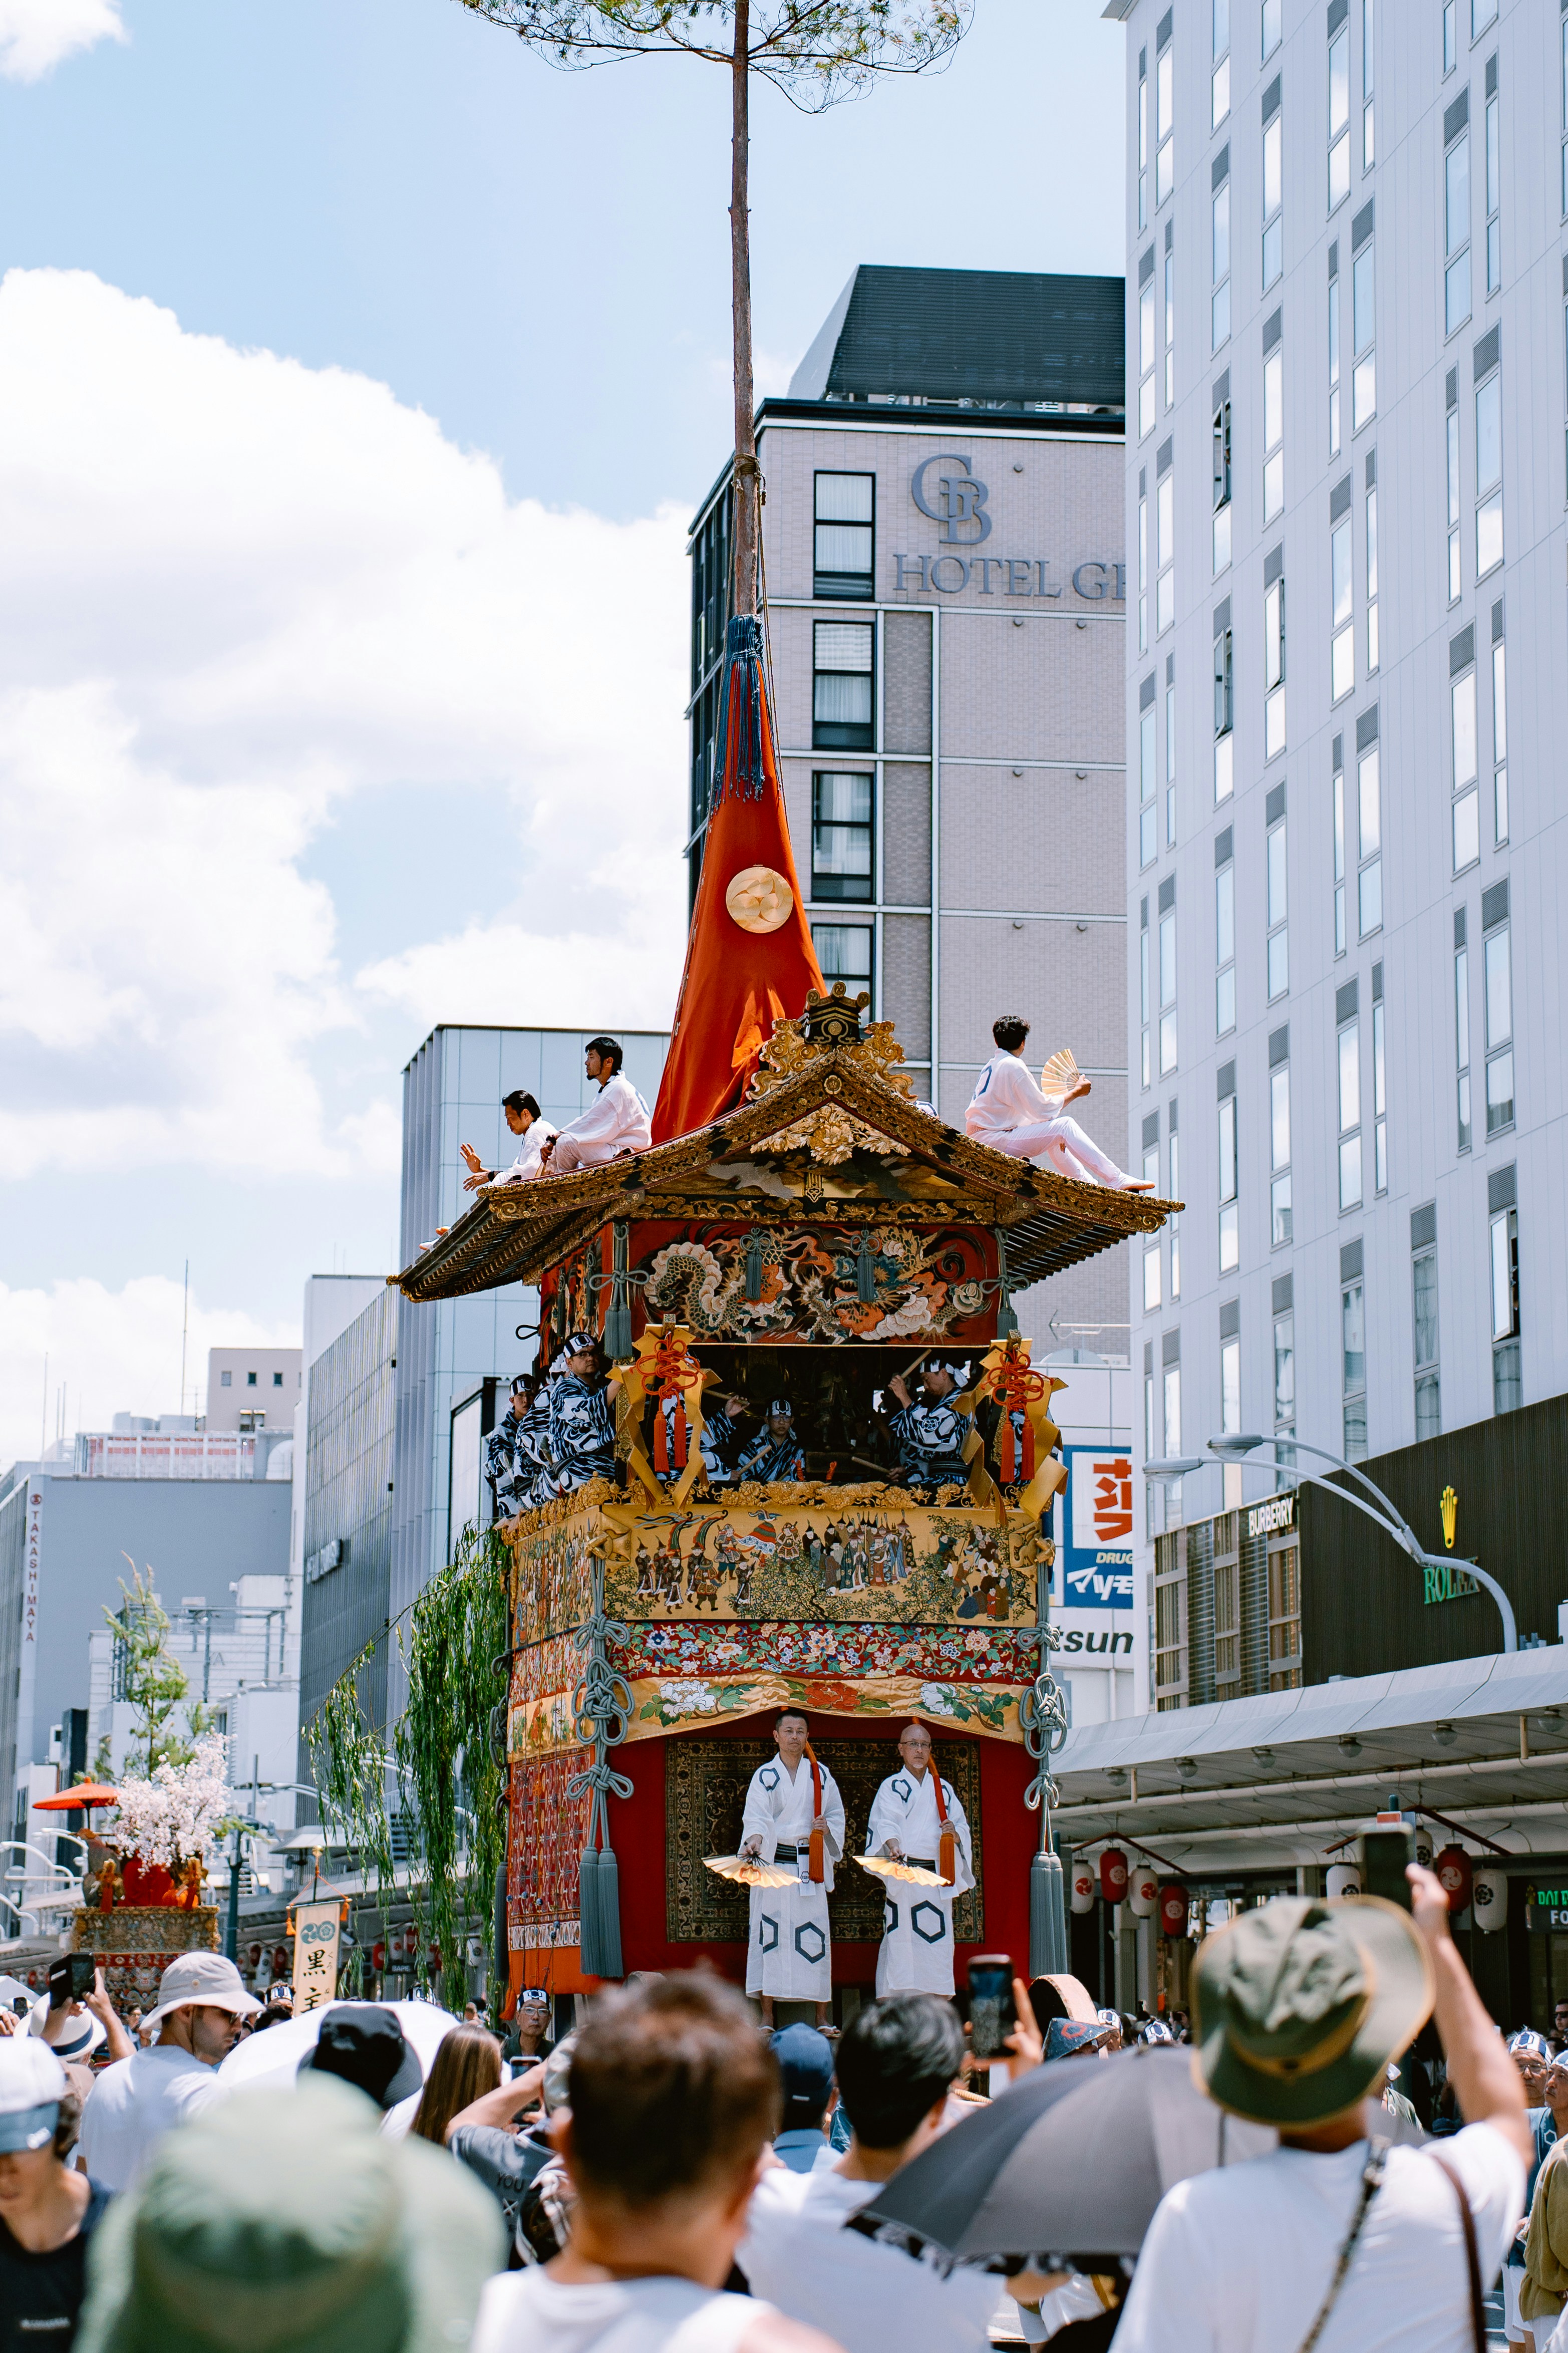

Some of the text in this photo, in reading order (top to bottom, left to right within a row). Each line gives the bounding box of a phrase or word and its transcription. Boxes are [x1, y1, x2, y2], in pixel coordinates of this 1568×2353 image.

[893, 554, 1062, 598] HOTEL
[1248, 1497, 1294, 1536] BURBERRY
[26, 1511, 39, 1641] TAKASHIMAYA
[1096, 1552, 1133, 1564] DRUG
[1067, 1566, 1133, 1600] マツモ
[300, 1949, 326, 2013] 黒主
[497, 2173, 524, 2192] YOU
